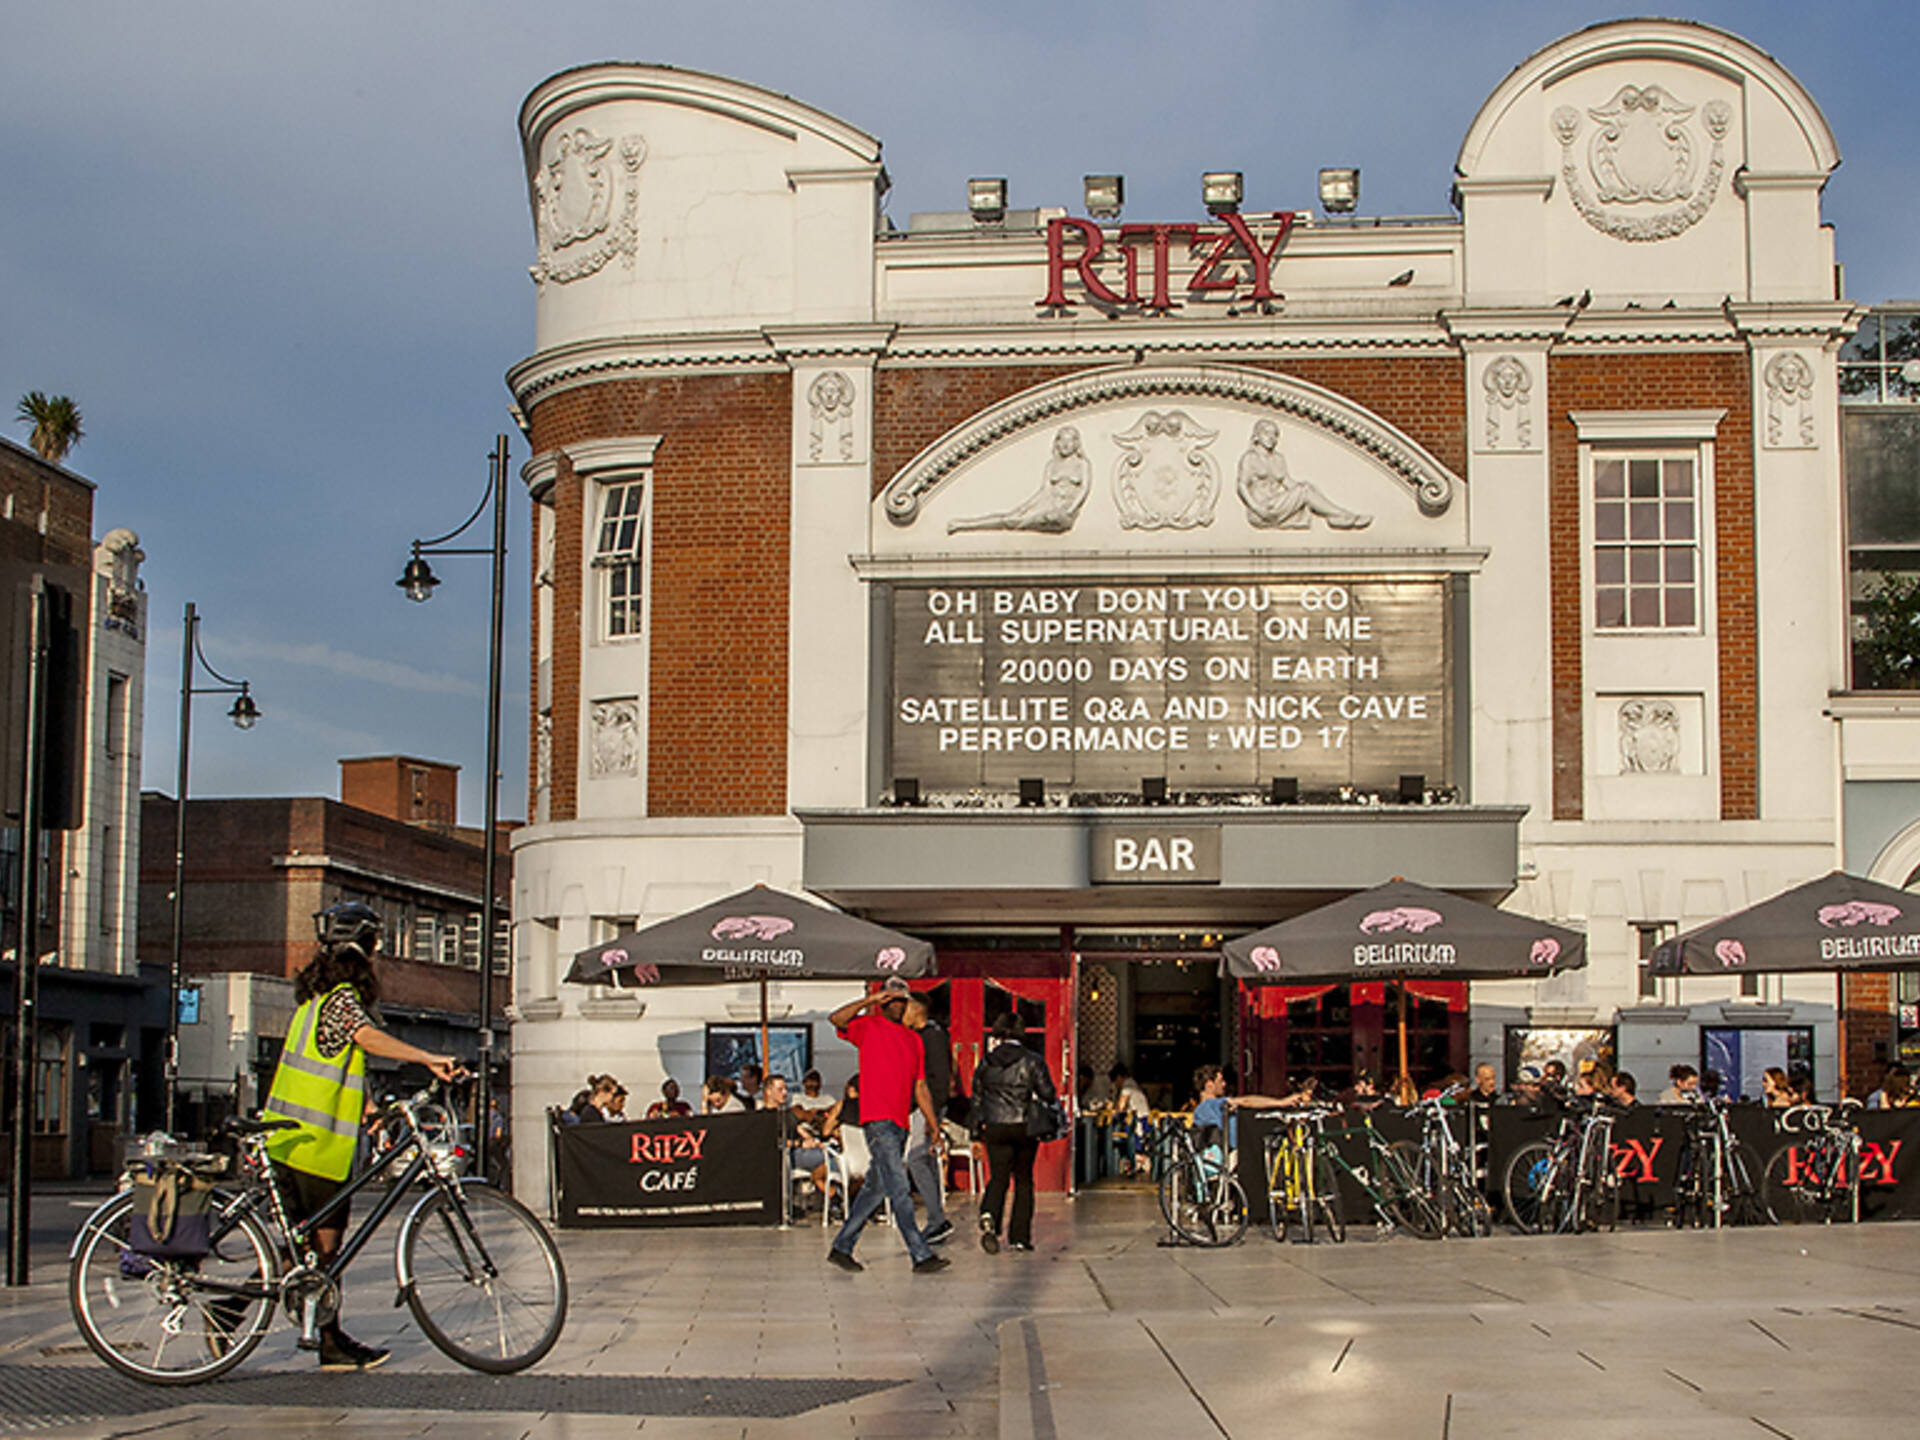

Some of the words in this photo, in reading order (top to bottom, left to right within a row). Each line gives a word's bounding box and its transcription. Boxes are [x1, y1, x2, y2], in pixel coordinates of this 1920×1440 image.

[1035, 211, 1295, 308] RITZY
[928, 590, 977, 616] OH
[994, 588, 1080, 614] BABY
[1098, 588, 1191, 613] DONT
[1202, 586, 1271, 611] YOU
[1300, 586, 1349, 611] GO
[924, 619, 984, 644] ALL
[1000, 617, 1248, 643] SUPERNATURAL
[1264, 616, 1308, 641] ON
[1325, 616, 1371, 641] ME
[1000, 657, 1093, 684] 20000
[1109, 657, 1188, 682] DAYS
[1204, 656, 1251, 681] ON
[1271, 655, 1379, 681] EARTH
[900, 697, 1069, 723] SATELLITE
[1083, 696, 1151, 723] Q&A
[1163, 696, 1229, 720] AND
[1245, 695, 1323, 720] NICK
[1339, 694, 1427, 720] CAVE
[939, 726, 1189, 752] PERFORMANCE
[1227, 725, 1302, 749] WED
[1317, 725, 1347, 749] 17
[1114, 837, 1196, 872] BAR
[702, 948, 804, 967] DELIRIUM
[1354, 943, 1456, 966] DELIRIUM
[628, 1129, 708, 1163] RITZY
[1782, 1139, 1902, 1188] RZY
[640, 1166, 698, 1192] CAFÉ
